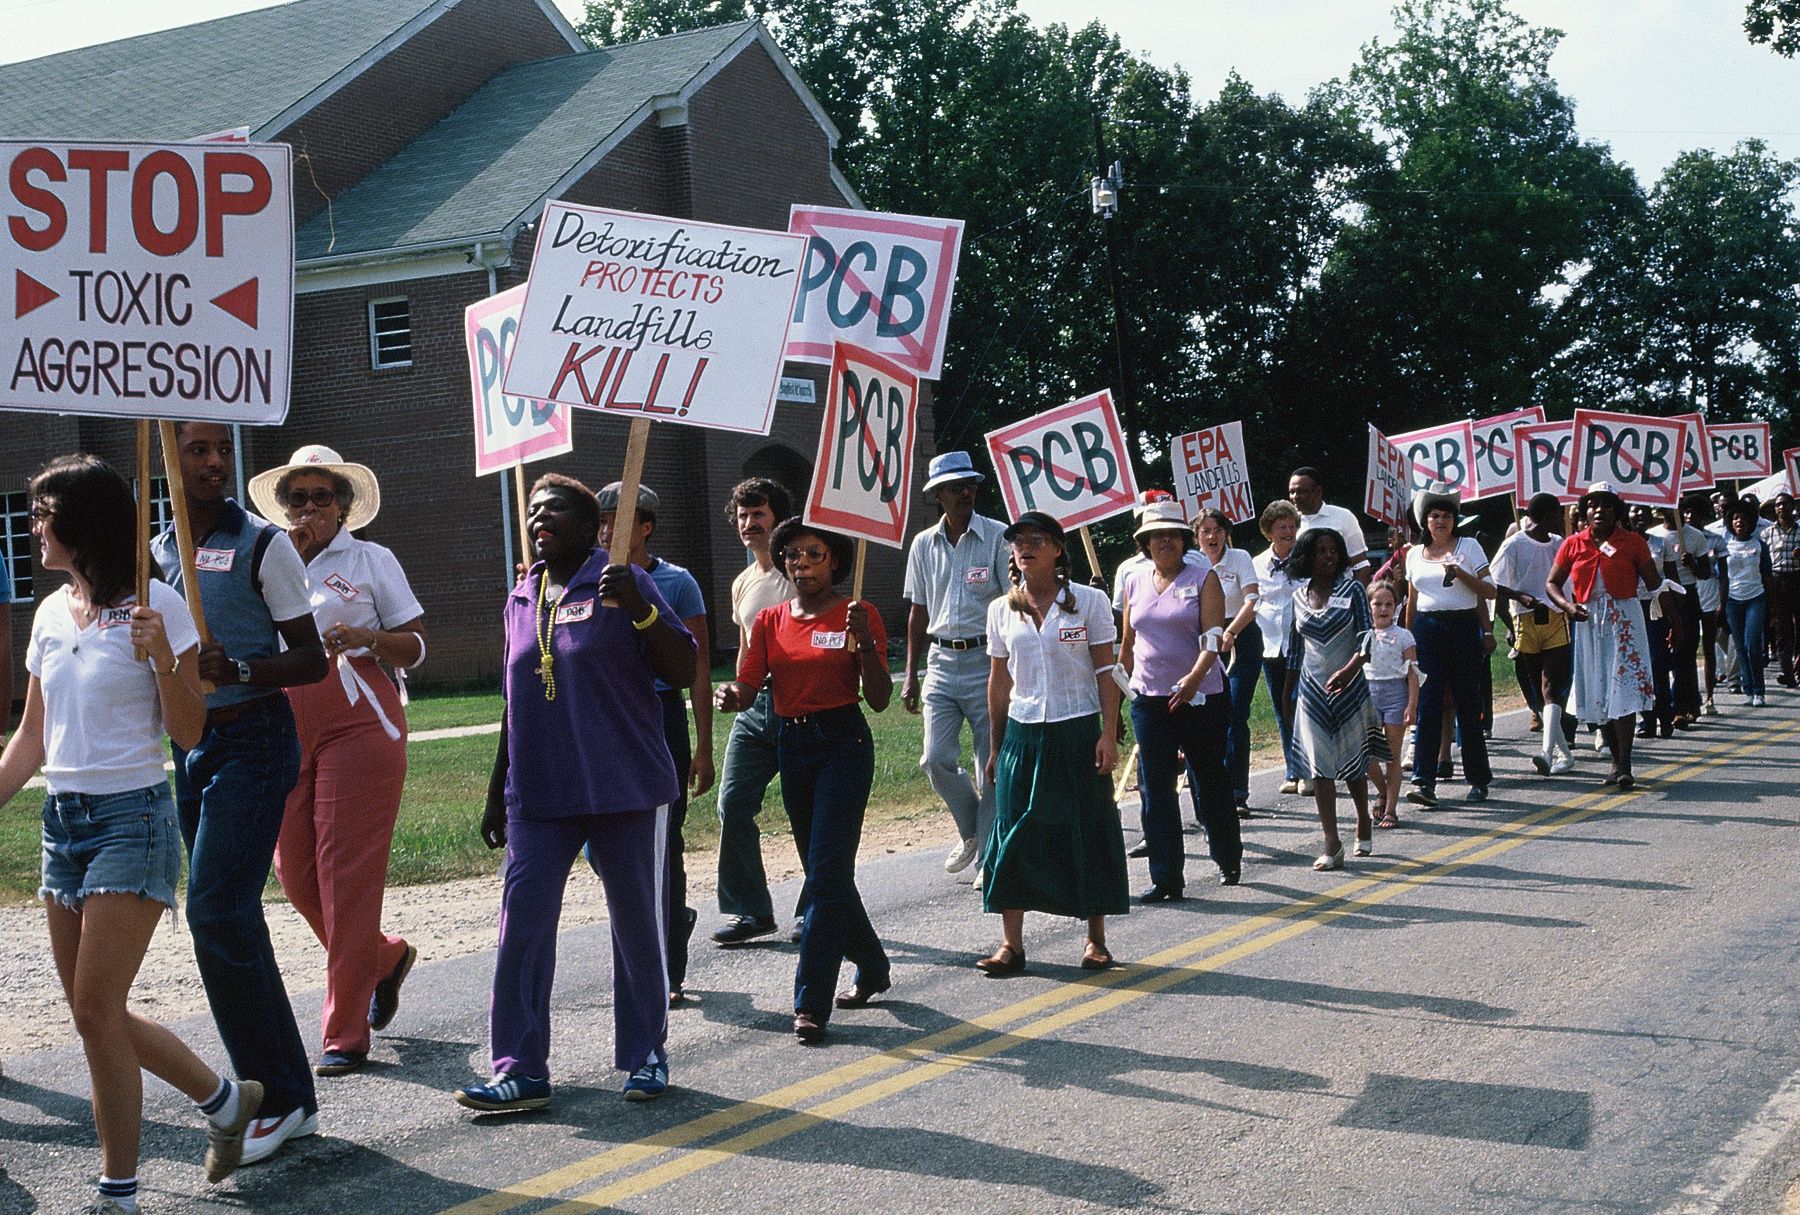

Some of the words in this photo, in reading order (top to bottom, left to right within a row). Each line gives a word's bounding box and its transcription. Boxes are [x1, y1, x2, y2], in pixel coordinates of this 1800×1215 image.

[8, 147, 273, 257] STOP
[552, 211, 795, 278] Detoxification
[69, 270, 193, 326] TOXIC
[580, 260, 724, 304] PROTECTS
[793, 236, 928, 337] PCB
[552, 295, 713, 351] Landfills
[10, 337, 272, 404] AGGRESSION
[549, 342, 709, 417] KILL!
[833, 370, 904, 503] PCB
[1008, 421, 1117, 512] PCB
[1182, 426, 1233, 474] EPA
[1408, 438, 1465, 495] CB
[1474, 421, 1531, 481] PC
[1529, 435, 1571, 493] PC
[1584, 424, 1670, 485] PCB
[1711, 434, 1759, 462] PCB
[1185, 462, 1241, 496] LANDFILLS
